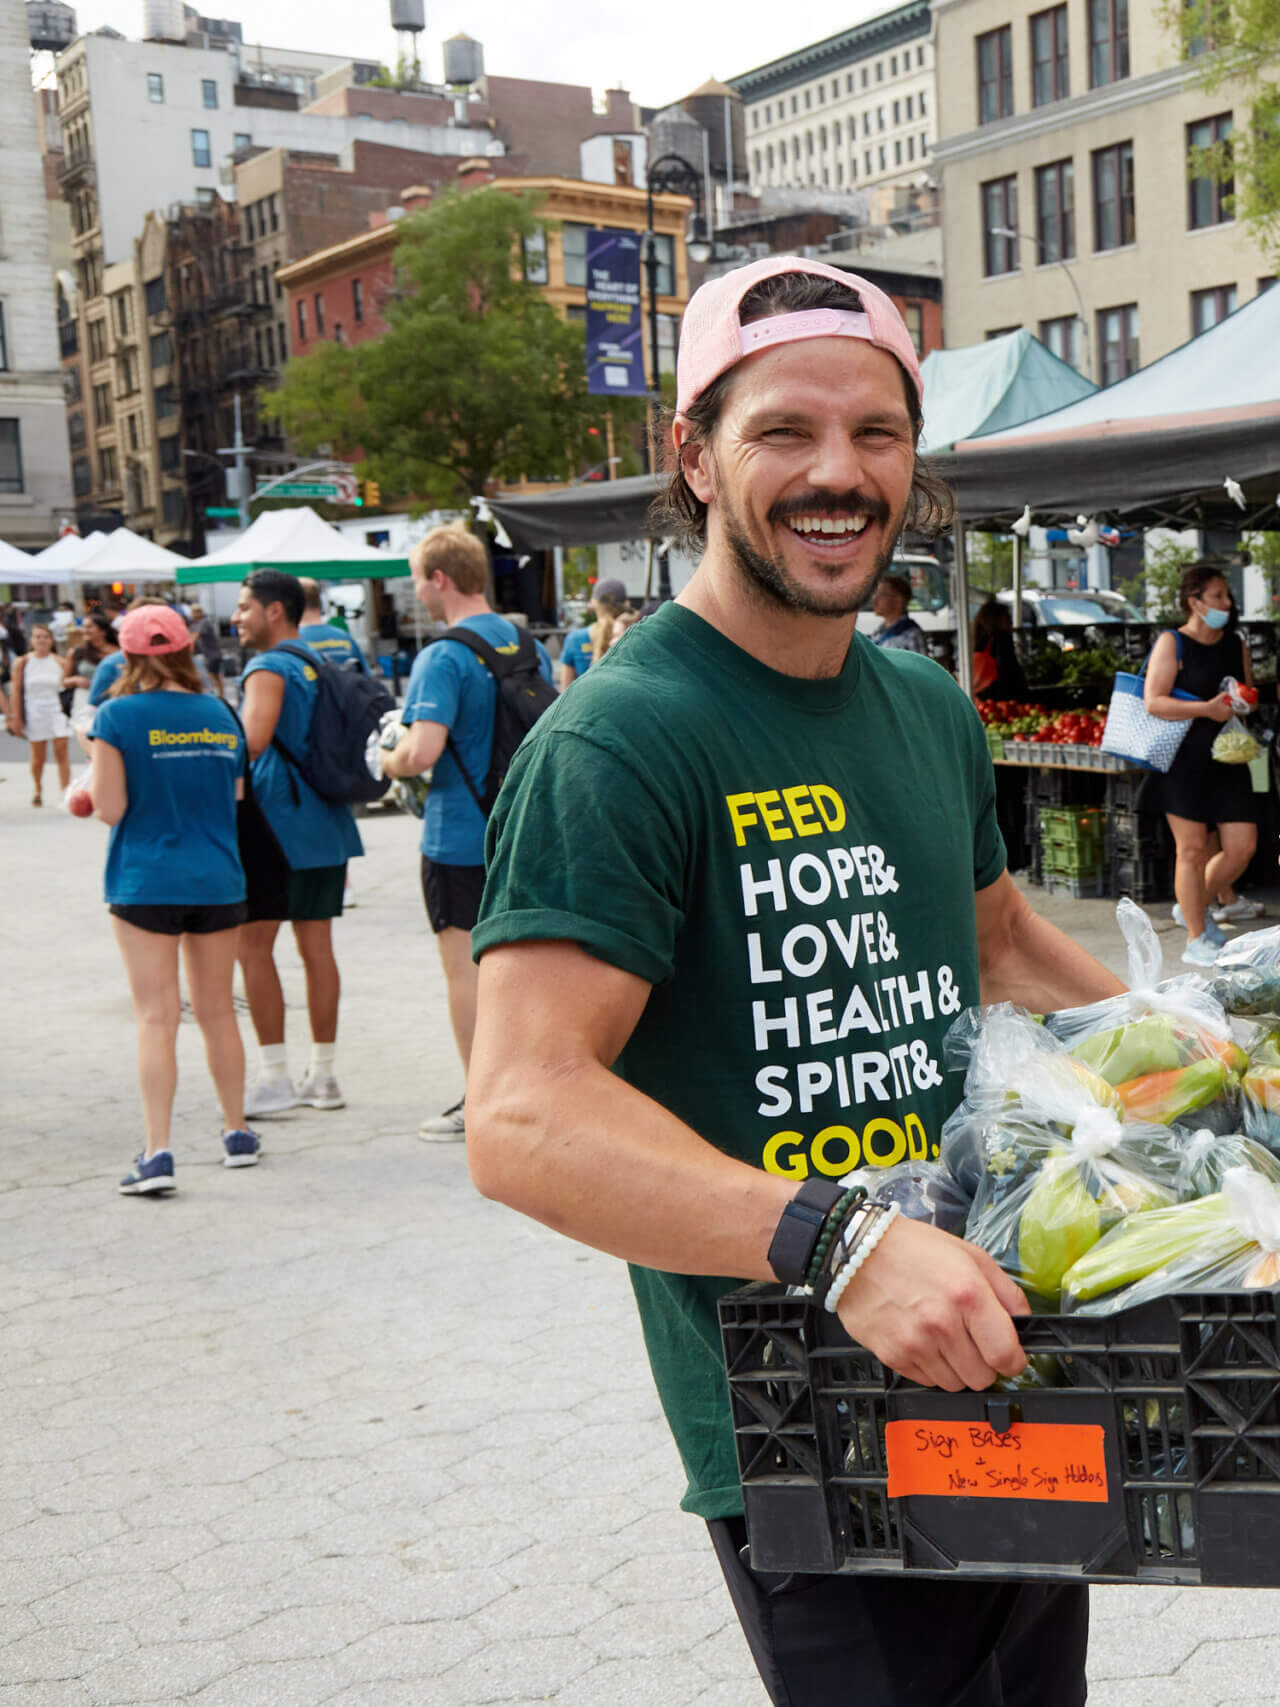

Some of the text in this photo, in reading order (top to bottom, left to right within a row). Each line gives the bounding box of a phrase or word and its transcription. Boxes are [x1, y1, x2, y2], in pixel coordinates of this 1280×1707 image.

[148, 728, 237, 750] Bloomberg
[725, 784, 847, 847] FEED
[762, 1112, 940, 1182] GOOD.
[914, 1427, 1023, 1458] Sign Bases
[948, 1469, 978, 1491] New
[1031, 1466, 1060, 1494] Sign
